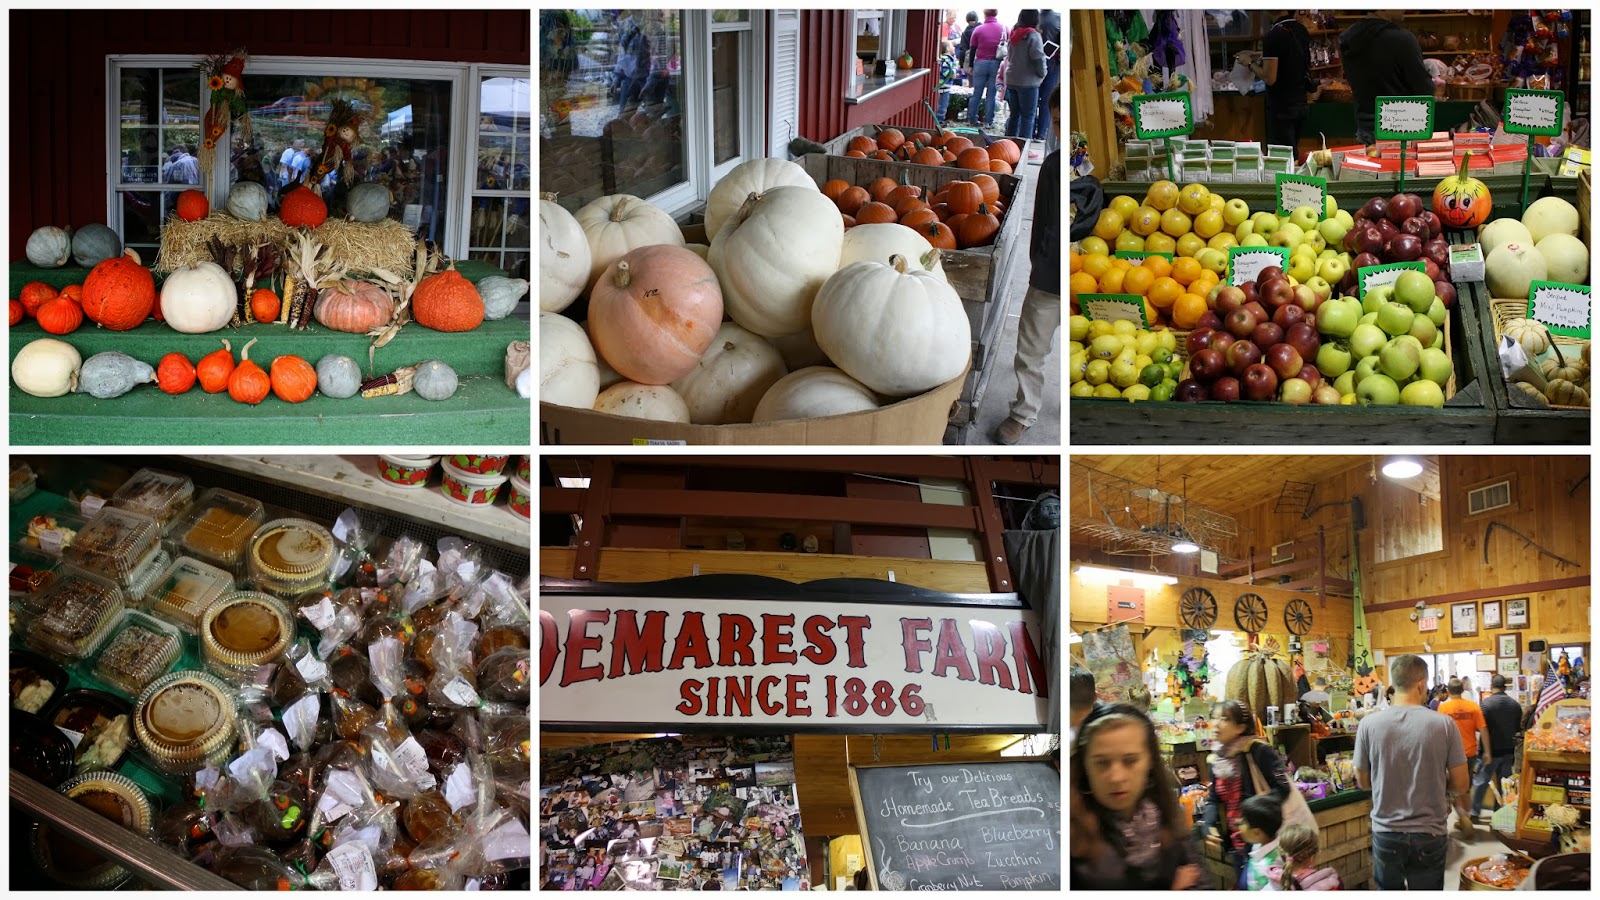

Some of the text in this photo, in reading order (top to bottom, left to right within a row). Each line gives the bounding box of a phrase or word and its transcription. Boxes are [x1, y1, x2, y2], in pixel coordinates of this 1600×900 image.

[1546, 292, 1567, 301] Striped
[1557, 303, 1583, 314] Pumpkins
[675, 674, 927, 718] SINCE 1886
[907, 768, 1013, 793] Try our Delicious
[880, 786, 1044, 818] Homemade Tea Breads
[896, 824, 1054, 852] Banana Blueberry
[986, 851, 1042, 868] Zucchini
[958, 874, 984, 888] Nut
[999, 872, 1055, 890] Pumpkin
